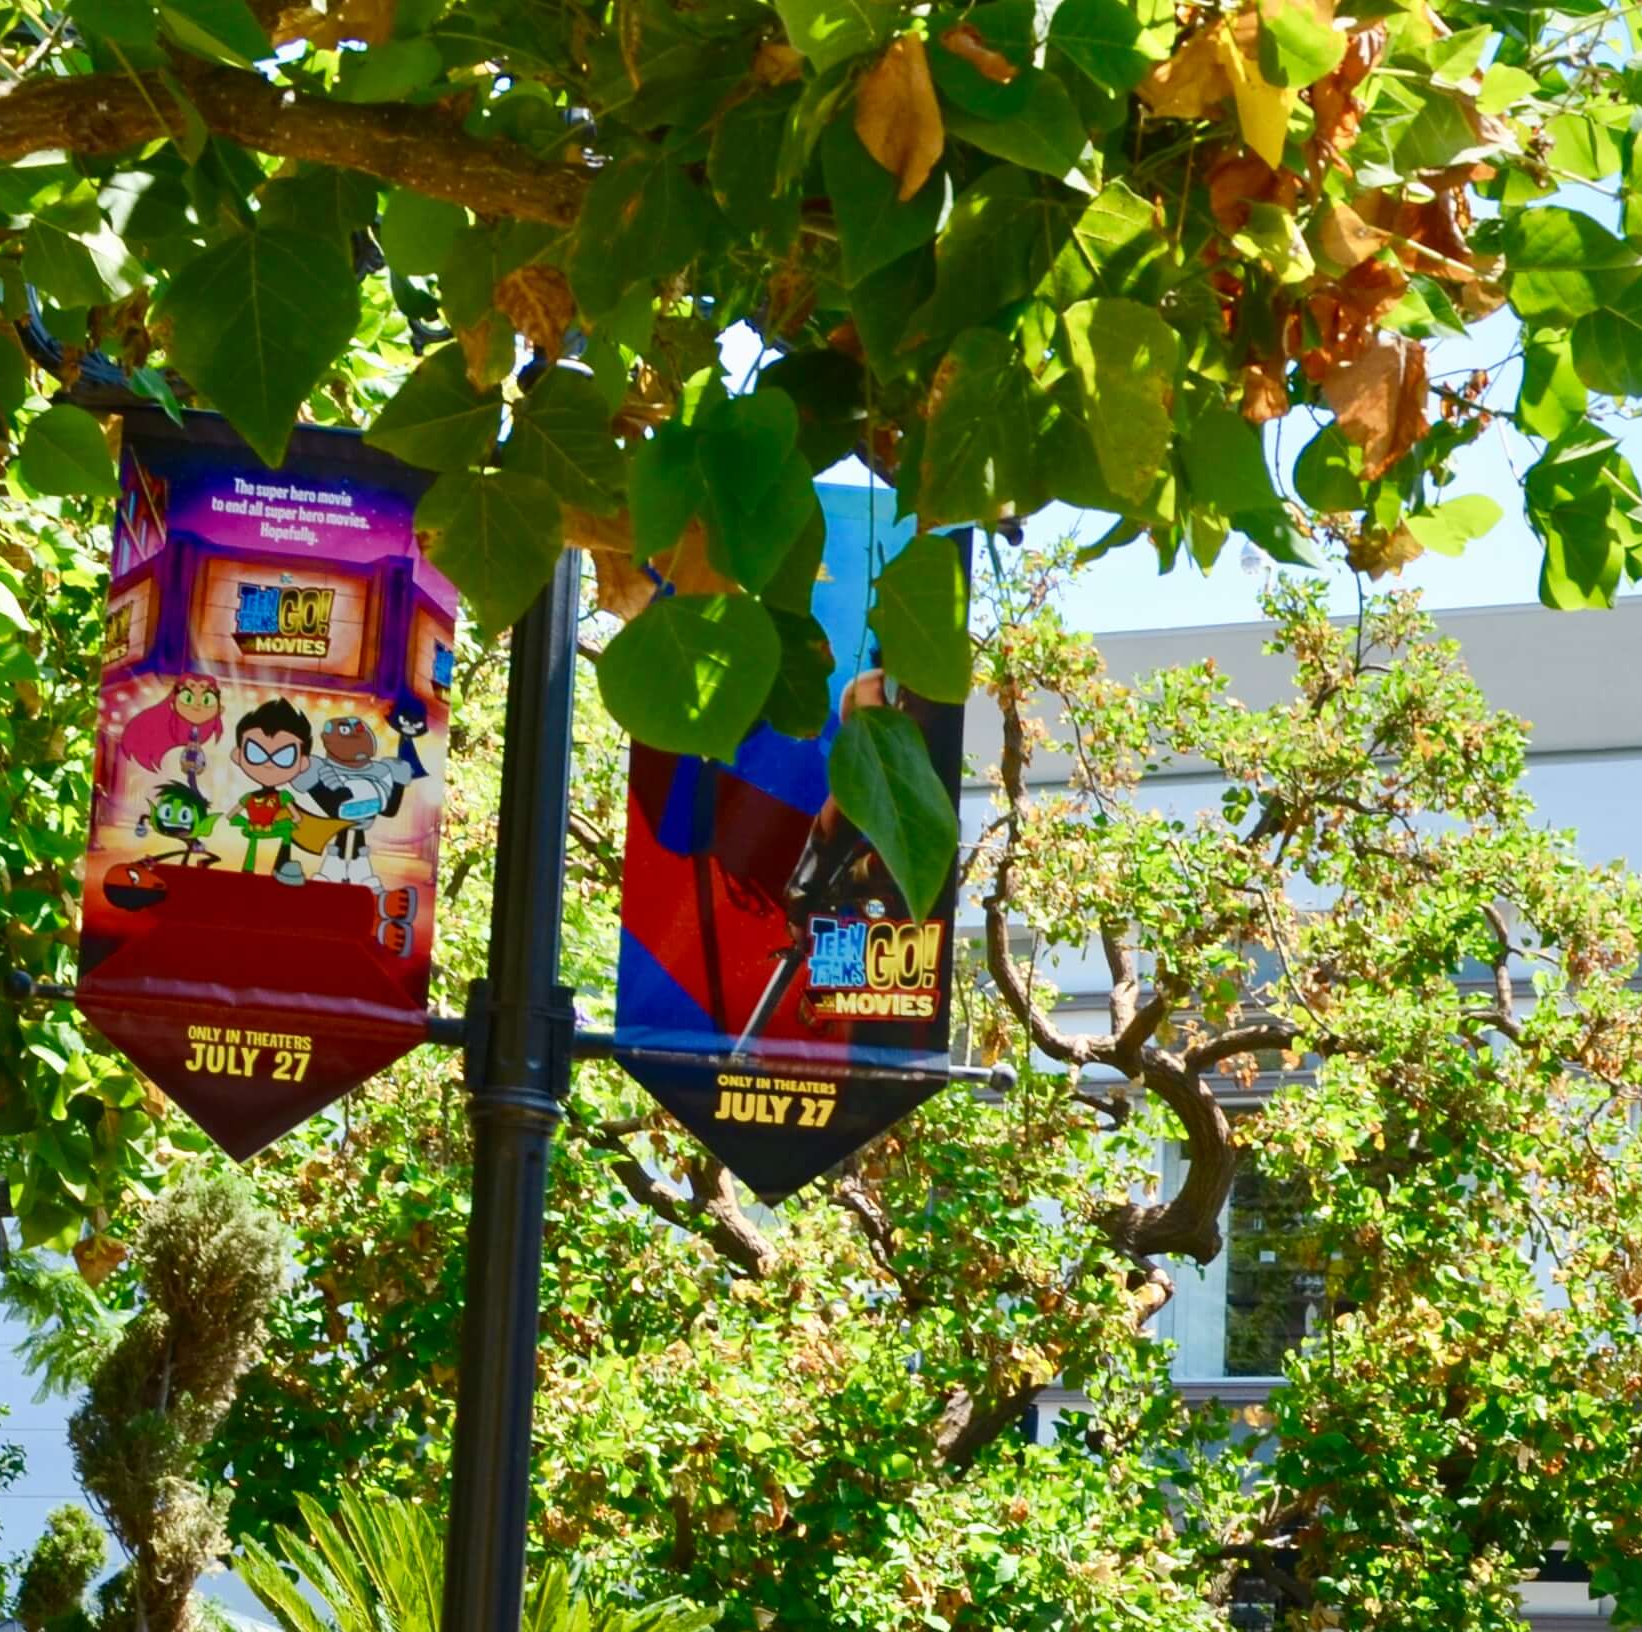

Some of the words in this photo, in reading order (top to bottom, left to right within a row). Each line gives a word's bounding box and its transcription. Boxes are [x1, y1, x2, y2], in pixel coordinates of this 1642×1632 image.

[233, 477, 255, 495] The
[257, 484, 289, 502] super
[290, 484, 317, 503] hero
[317, 491, 353, 507] movie
[211, 496, 225, 511] to
[225, 499, 247, 515] end
[248, 501, 263, 517] all
[264, 505, 298, 523] super
[299, 506, 325, 523] hero
[325, 511, 371, 529] movies.
[260, 521, 319, 546] Hopefully.
[278, 587, 335, 637] GO!
[255, 636, 327, 656] MOVIES
[866, 921, 942, 991] GO!
[835, 991, 935, 1017] MOVIES
[187, 1025, 221, 1043] ONLY
[225, 1028, 241, 1045] IN
[244, 1029, 313, 1052] THEATERS
[184, 1042, 260, 1078] JULY
[271, 1052, 312, 1083] 27
[717, 1074, 754, 1090] ONLY
[756, 1076, 771, 1091] IN
[773, 1076, 837, 1095] THEATERS
[714, 1092, 791, 1125] JULY
[797, 1098, 838, 1128] 27
